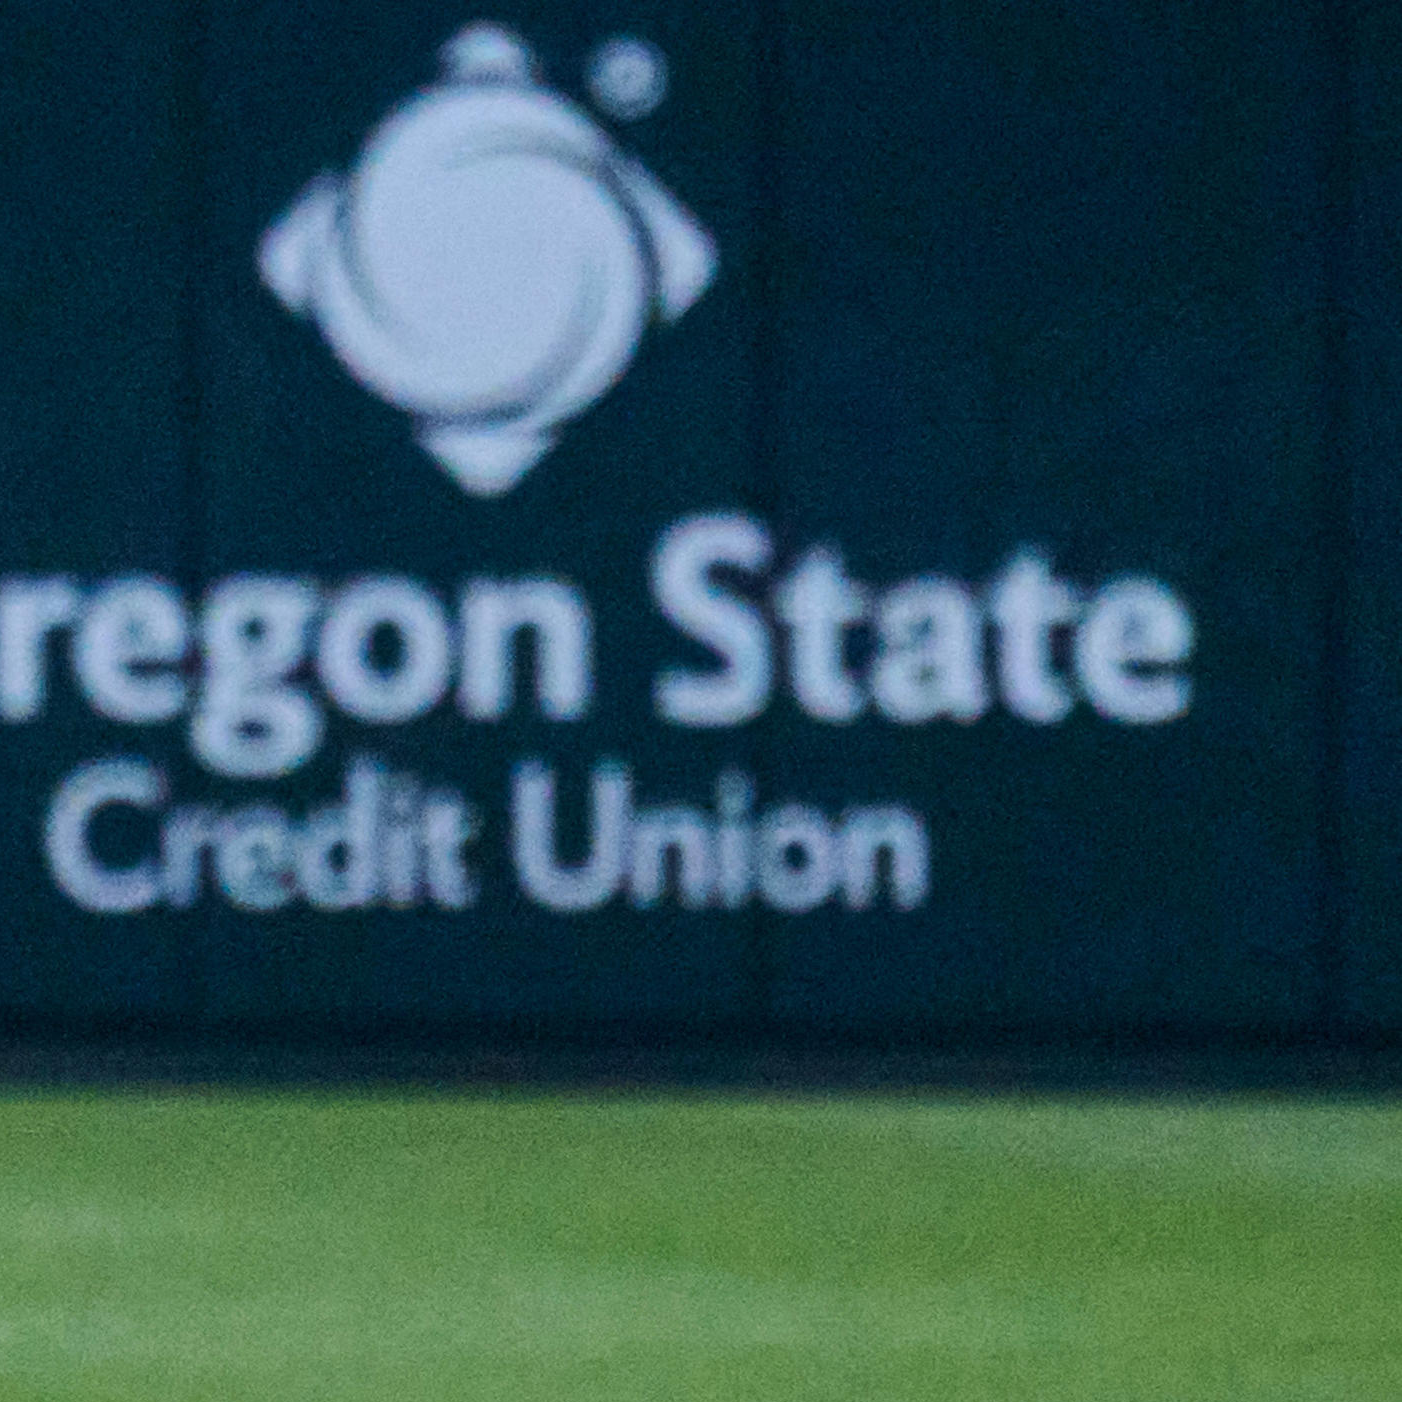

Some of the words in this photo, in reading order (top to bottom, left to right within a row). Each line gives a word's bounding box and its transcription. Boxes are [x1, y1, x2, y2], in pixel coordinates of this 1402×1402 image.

[652, 512, 1194, 726] State
[44, 758, 474, 913] Credit
[511, 762, 930, 910] Union
